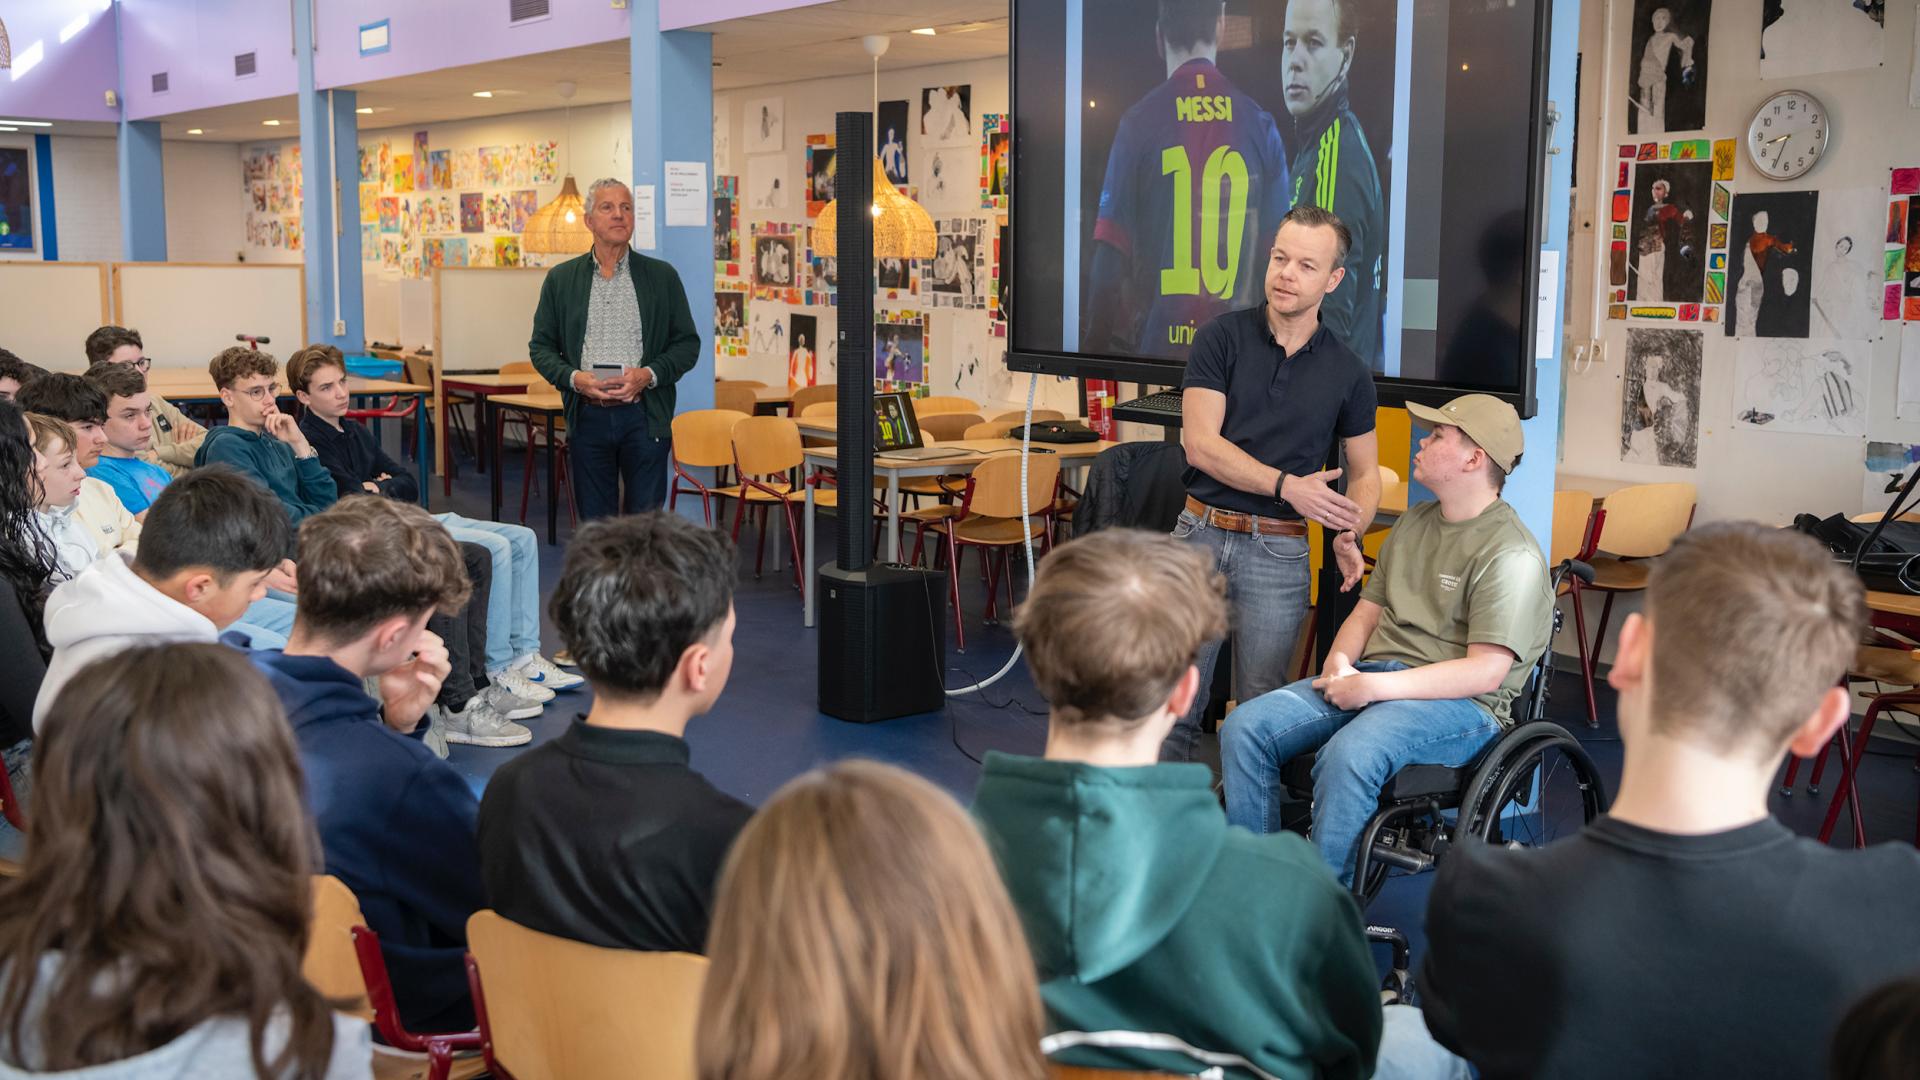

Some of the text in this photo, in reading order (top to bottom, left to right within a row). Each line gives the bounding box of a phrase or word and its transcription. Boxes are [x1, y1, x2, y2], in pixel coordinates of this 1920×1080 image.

[1175, 96, 1232, 122] MESSI
[1787, 100, 1796, 110] 12
[1803, 103, 1807, 112] 1
[1774, 106, 1781, 115] 11
[1763, 118, 1772, 127] 10
[1811, 114, 1818, 124] 2
[1757, 132, 1763, 142] 9
[1815, 129, 1821, 139] 3
[1761, 148, 1767, 158] 8
[1808, 146, 1815, 155] 4
[1772, 158, 1778, 168] 7
[1783, 162, 1790, 171] 6
[1798, 157, 1804, 167] 5
[1161, 145, 1249, 299] 10
